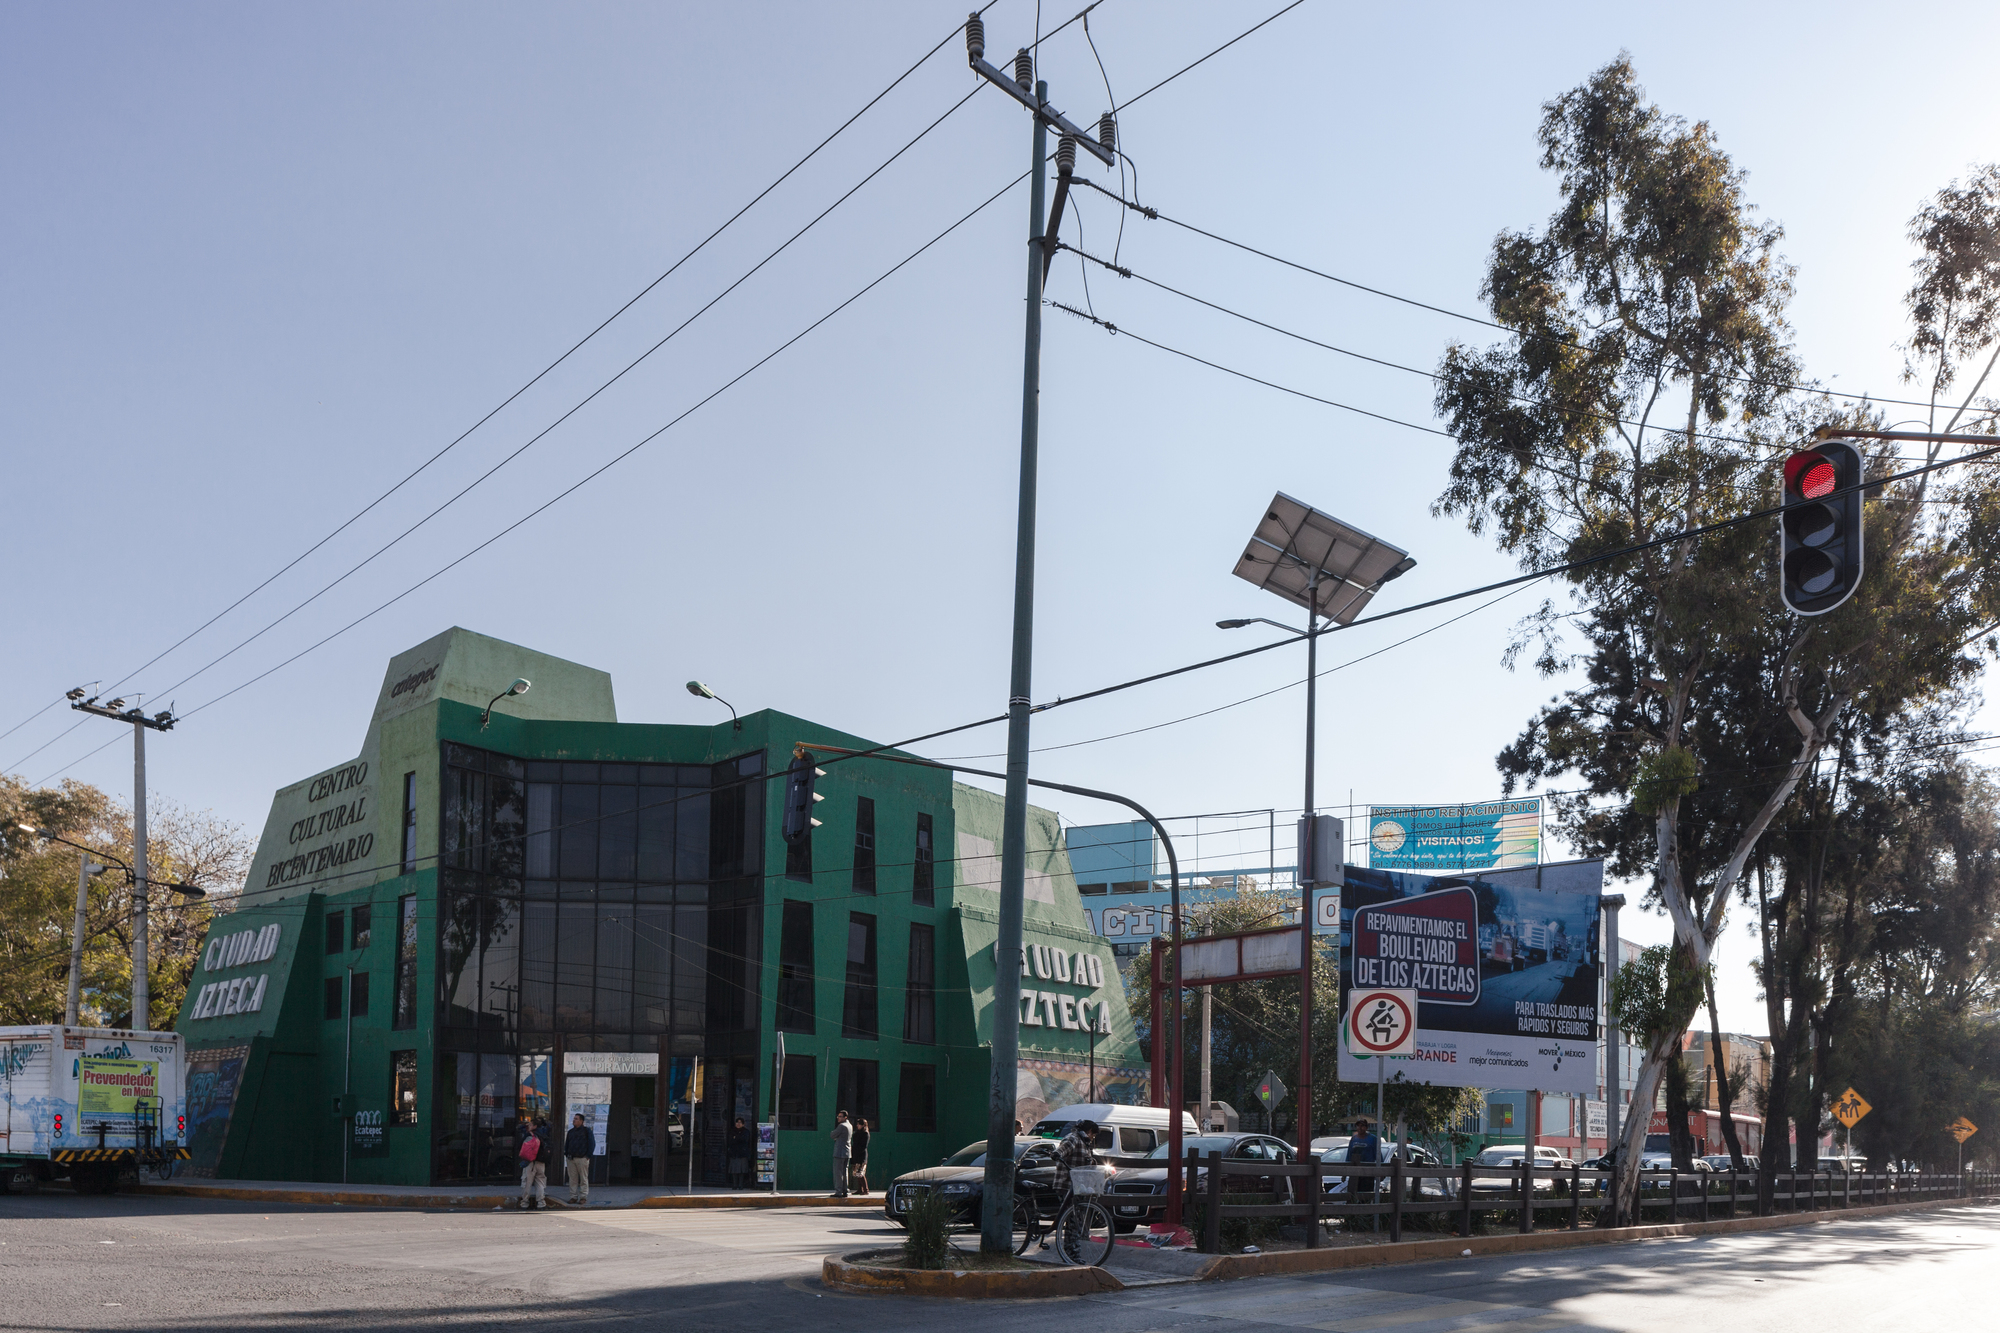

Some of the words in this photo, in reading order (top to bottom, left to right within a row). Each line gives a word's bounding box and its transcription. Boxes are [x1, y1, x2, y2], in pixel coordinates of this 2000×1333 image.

[308, 761, 368, 803] CENTRO
[1371, 807, 1436, 818] INSTITUTO
[1439, 801, 1538, 817] RENACIMIENTO
[289, 797, 366, 845] CULTURAL
[1410, 822, 1442, 830] SOMOS
[1417, 836, 1485, 847] ¡VISITANOS!
[266, 832, 374, 888] BICENTENARIO
[1367, 912, 1454, 938] REPAVIMENTAMOS
[1456, 922, 1468, 940] EL
[204, 923, 282, 972] CIUDAD
[1380, 933, 1456, 964] BOULEVARD
[994, 940, 1105, 988] IUDAD
[1358, 957, 1378, 985] DE
[1380, 959, 1409, 987] LOS
[1411, 962, 1475, 993] AZTECAS
[189, 974, 269, 1020] AZTECA
[1018, 988, 1113, 1035] ZTECA
[1515, 1001, 1535, 1016] PARA
[1536, 1002, 1577, 1020] TRASLADOS
[1578, 1004, 1595, 1021] MÁS
[1518, 1014, 1550, 1033] RÁPIDOS
[1550, 1020, 1557, 1033] Y
[1557, 1020, 1589, 1036] SEGUROS
[149, 1045, 173, 1054] 16317
[1538, 1048, 1558, 1056] MOVER
[1564, 1049, 1586, 1058] MÉXICO
[1469, 1055, 1487, 1067] mejor
[1488, 1057, 1529, 1067] comunicados
[83, 1070, 156, 1087] Prevendedor
[121, 1087, 133, 1097] en
[133, 1086, 154, 1097] Moto
[355, 1126, 382, 1137] Ecatepec
